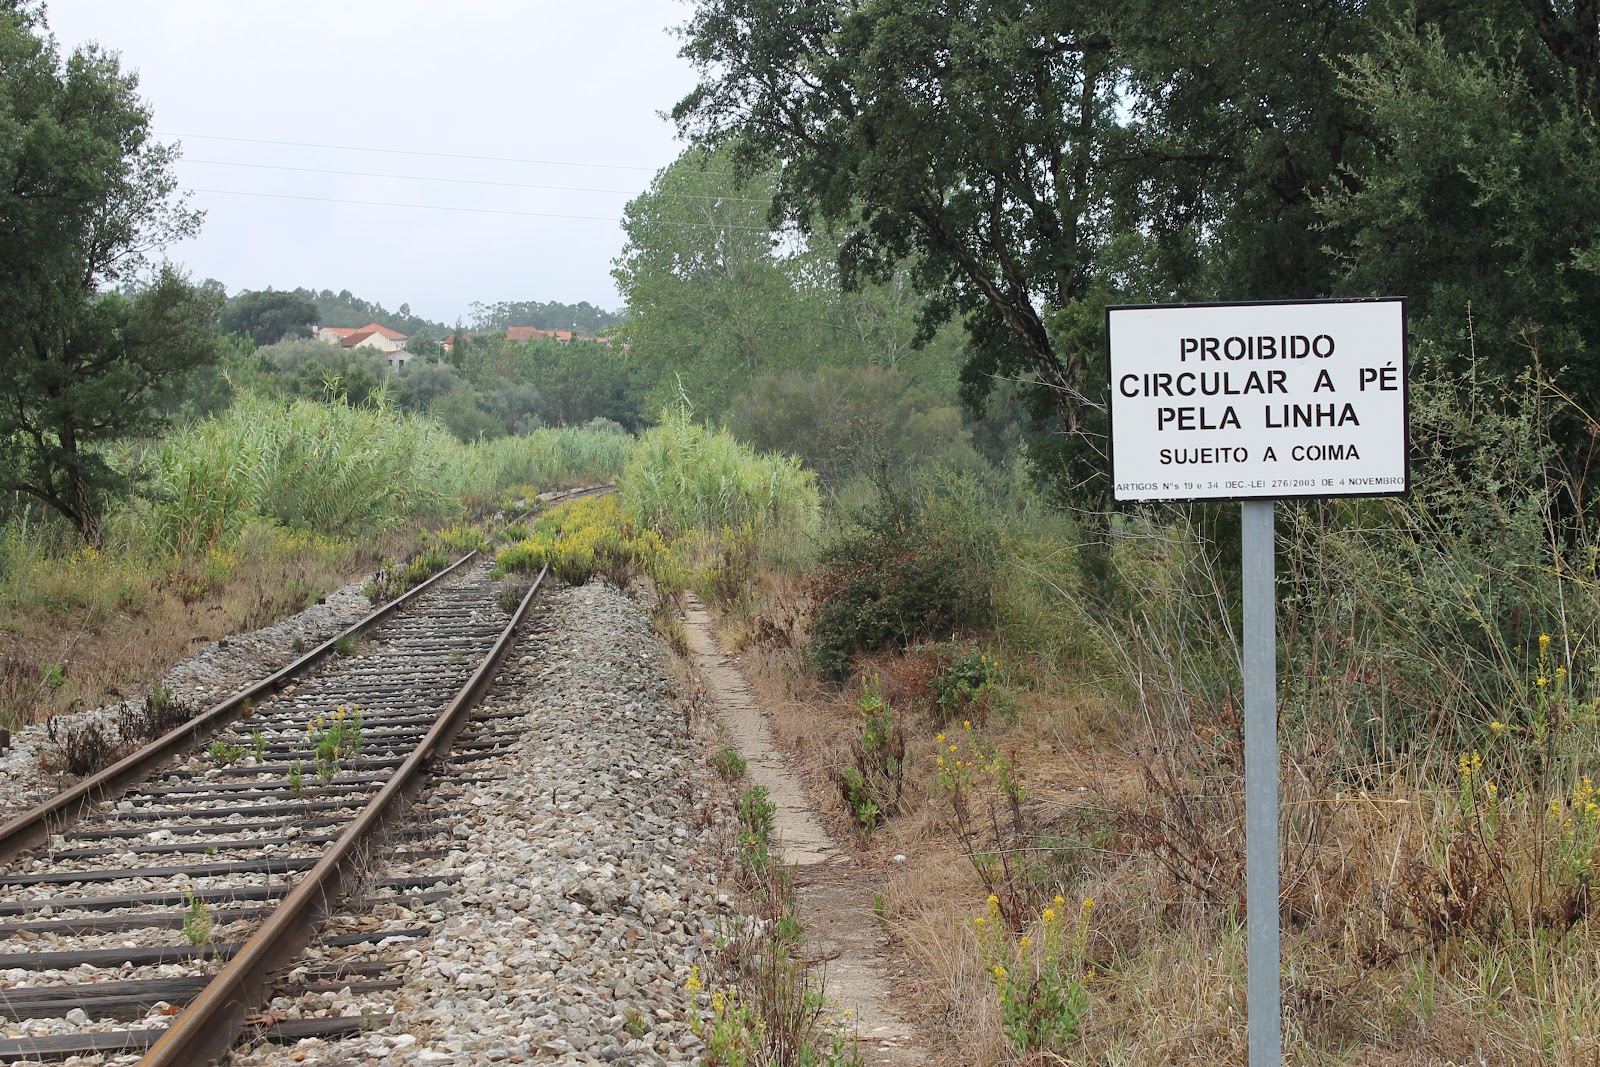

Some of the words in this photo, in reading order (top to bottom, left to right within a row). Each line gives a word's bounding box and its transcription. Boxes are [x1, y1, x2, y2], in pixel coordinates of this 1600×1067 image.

[1180, 334, 1336, 362] PROIBIDO
[1119, 370, 1289, 398] CIRCULAR
[1312, 369, 1336, 393] A
[1359, 361, 1398, 392] PÉ
[1157, 405, 1242, 432] PELA
[1265, 403, 1361, 429] LINHA
[1159, 446, 1249, 465] SUJEITO
[1262, 446, 1278, 462] A
[1291, 444, 1361, 462] COIMA
[1116, 482, 1158, 491] ARTIGOS
[1184, 482, 1193, 490] 19
[1207, 482, 1219, 490] 34
[1225, 480, 1266, 489] DEC.-LEI
[1271, 479, 1316, 488] 276/2003
[1321, 478, 1334, 487] DE
[1339, 478, 1345, 486] 4
[1348, 476, 1405, 486] NOVEMBRO
